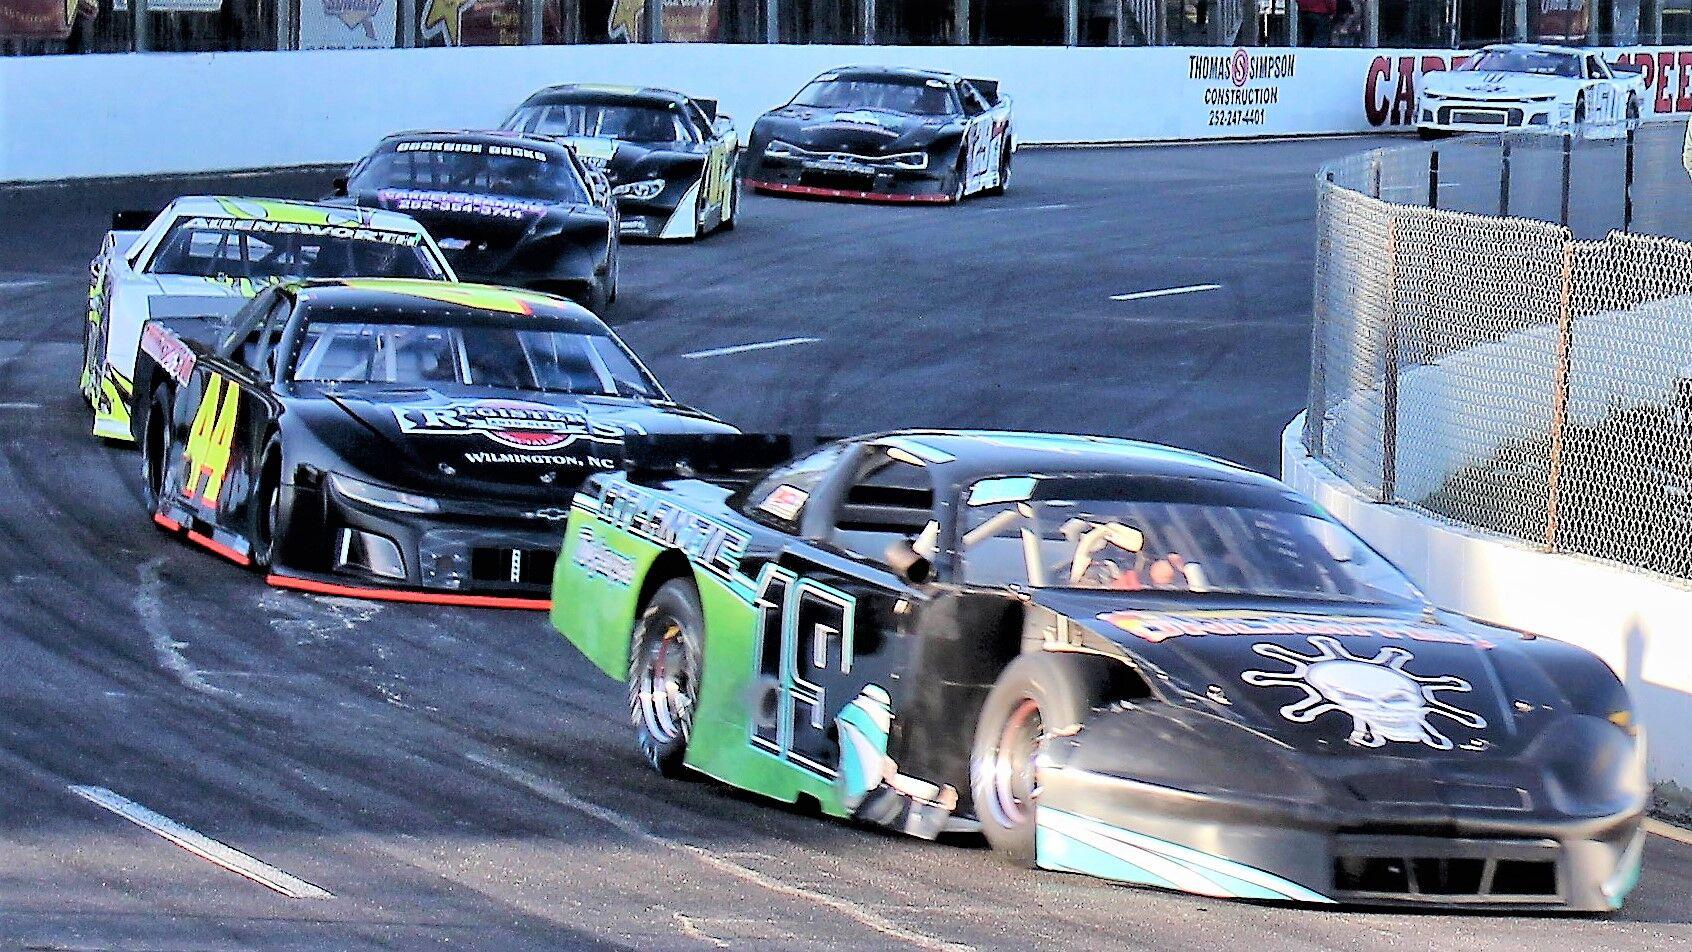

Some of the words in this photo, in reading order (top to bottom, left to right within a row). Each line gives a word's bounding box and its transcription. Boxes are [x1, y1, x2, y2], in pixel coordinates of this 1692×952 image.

[1189, 55, 1231, 80] THOMAS
[1249, 54, 1295, 79] SIMPSON
[1204, 87, 1278, 105] CONSTRUCTION
[1208, 108, 1265, 126] 252-247-4401
[397, 141, 482, 153] DOCKSIDE
[488, 145, 547, 162] DOCKS
[182, 371, 240, 510] 44
[465, 452, 584, 467] WILMINGTON,
[588, 455, 615, 469] NC
